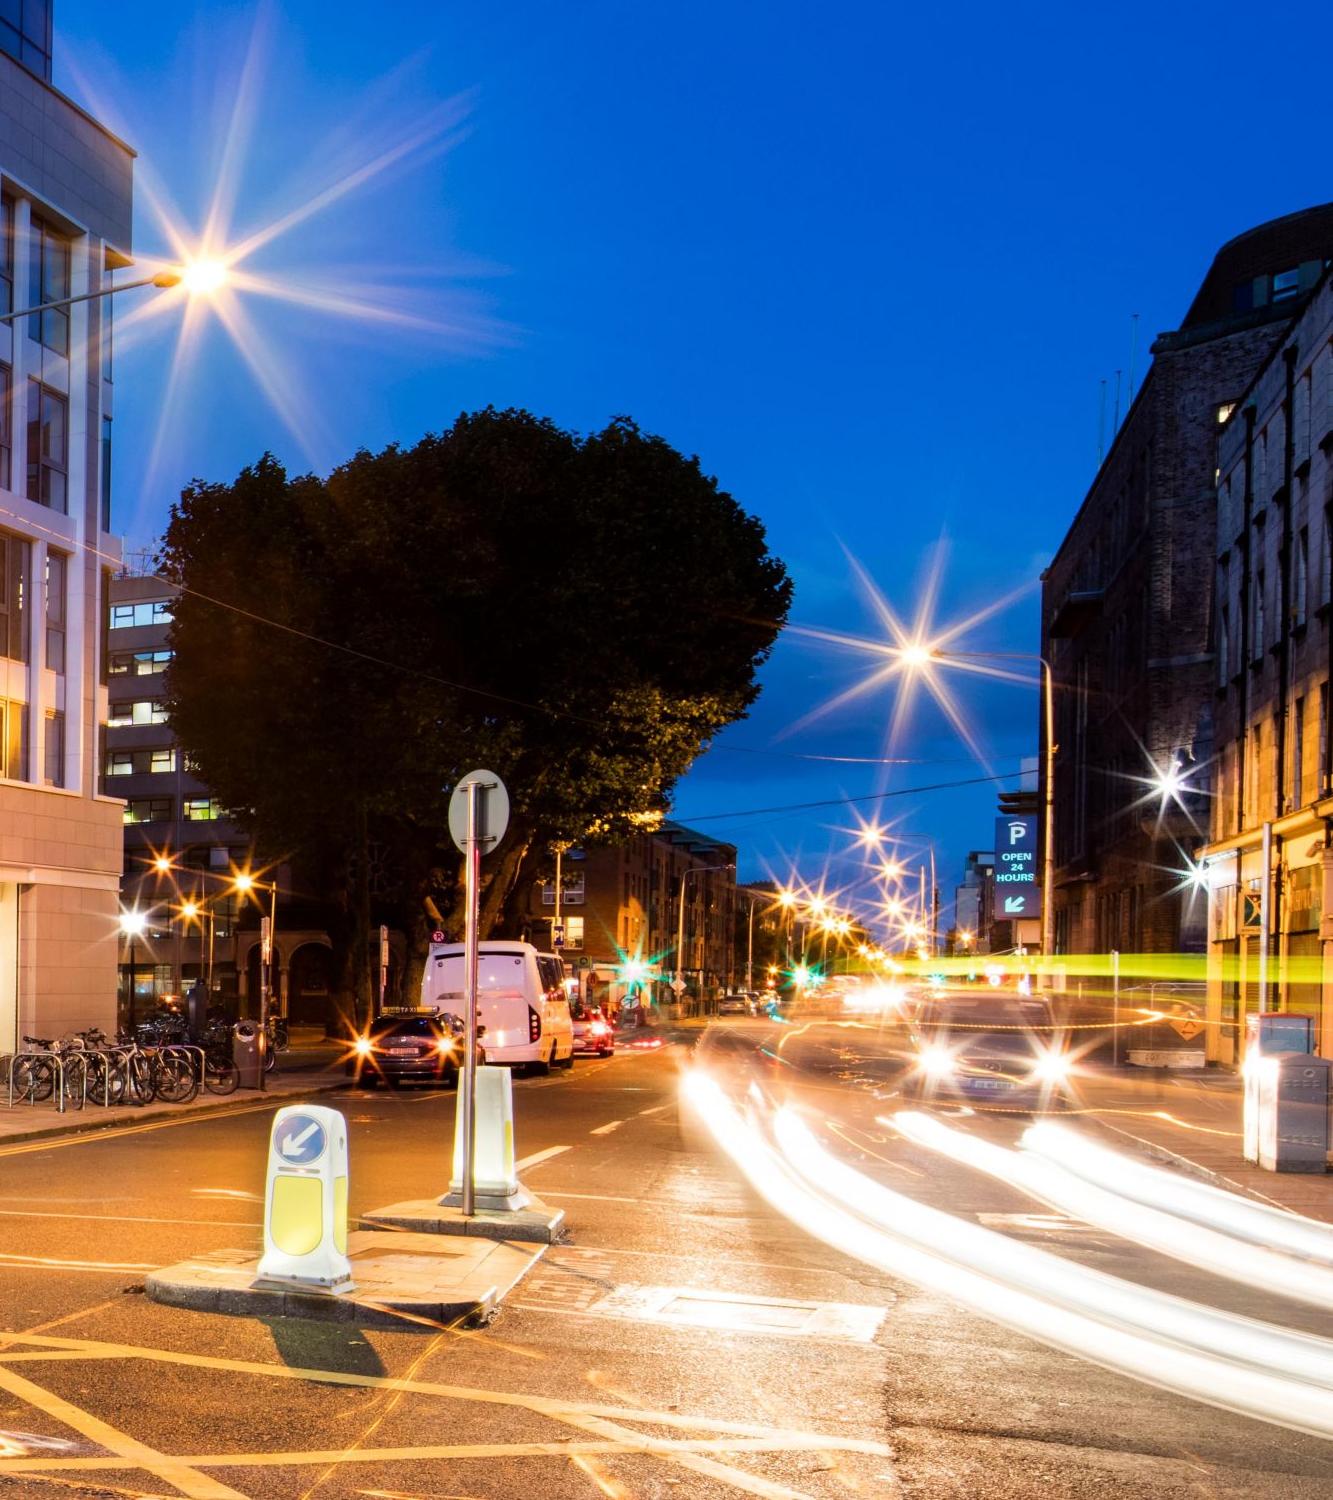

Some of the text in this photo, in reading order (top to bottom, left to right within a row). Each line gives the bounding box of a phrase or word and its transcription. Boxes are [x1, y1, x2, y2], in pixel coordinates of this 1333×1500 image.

[1010, 826, 1026, 845] P
[1002, 853, 1032, 861] OPEN
[1010, 863, 1024, 871] 24
[996, 873, 1034, 882] HOURS
